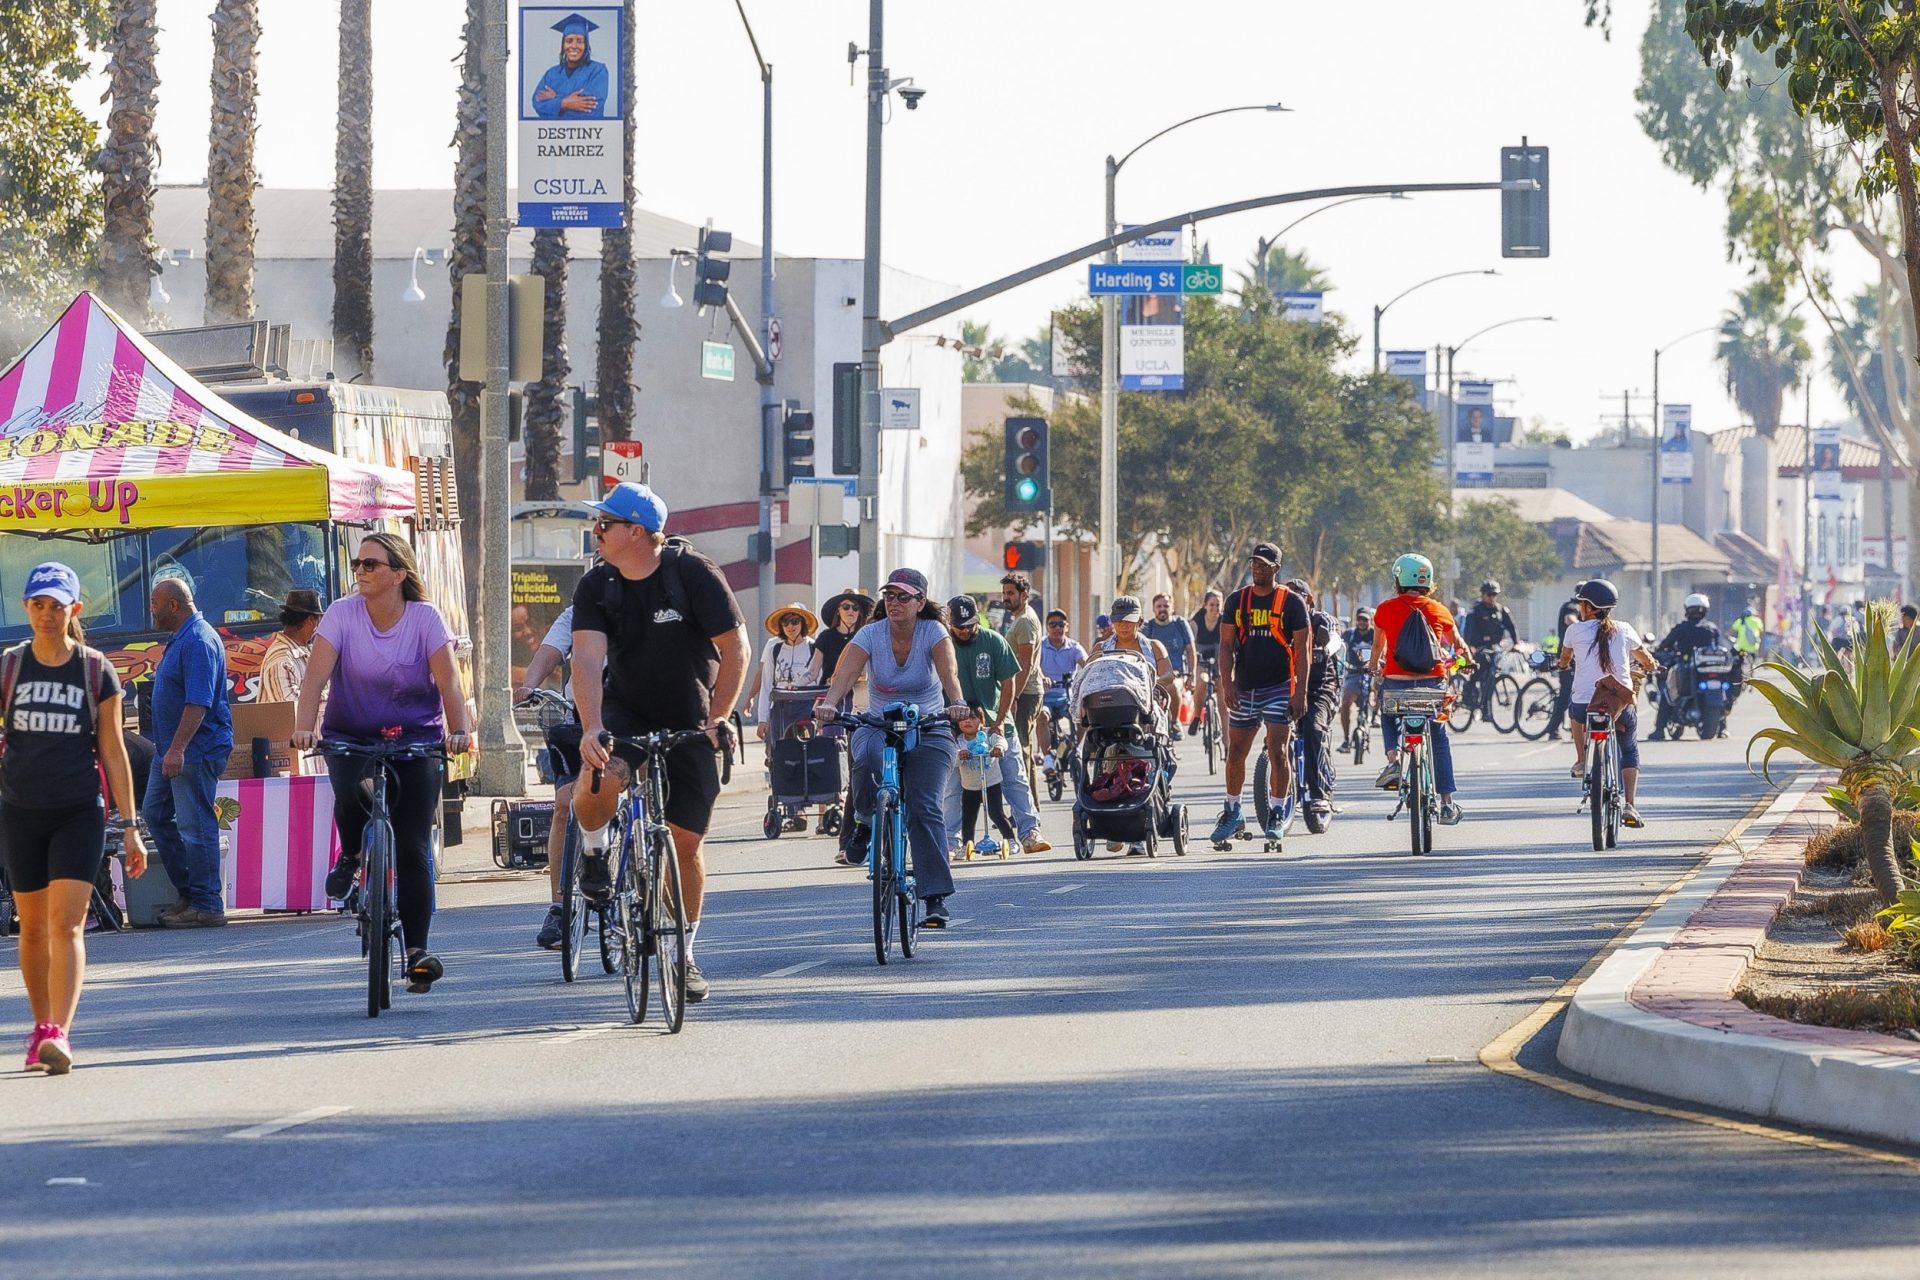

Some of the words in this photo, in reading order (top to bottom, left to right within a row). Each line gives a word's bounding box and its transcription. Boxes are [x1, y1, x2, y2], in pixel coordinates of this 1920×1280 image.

[537, 127, 603, 140] DESTINY
[537, 145, 604, 157] RAMIREZ
[534, 178, 607, 195] CSULA
[1095, 272, 1152, 291] Harding
[1158, 272, 1175, 287] St
[1135, 360, 1170, 371] UCLA
[616, 462, 629, 476] 61
[511, 572, 549, 583] Triplica
[513, 582, 557, 593] felicidad
[512, 593, 524, 603] tu
[524, 593, 561, 603] factura
[14, 681, 86, 710] ZULU
[13, 710, 82, 734] SOUL
[516, 723, 544, 732] erizo
